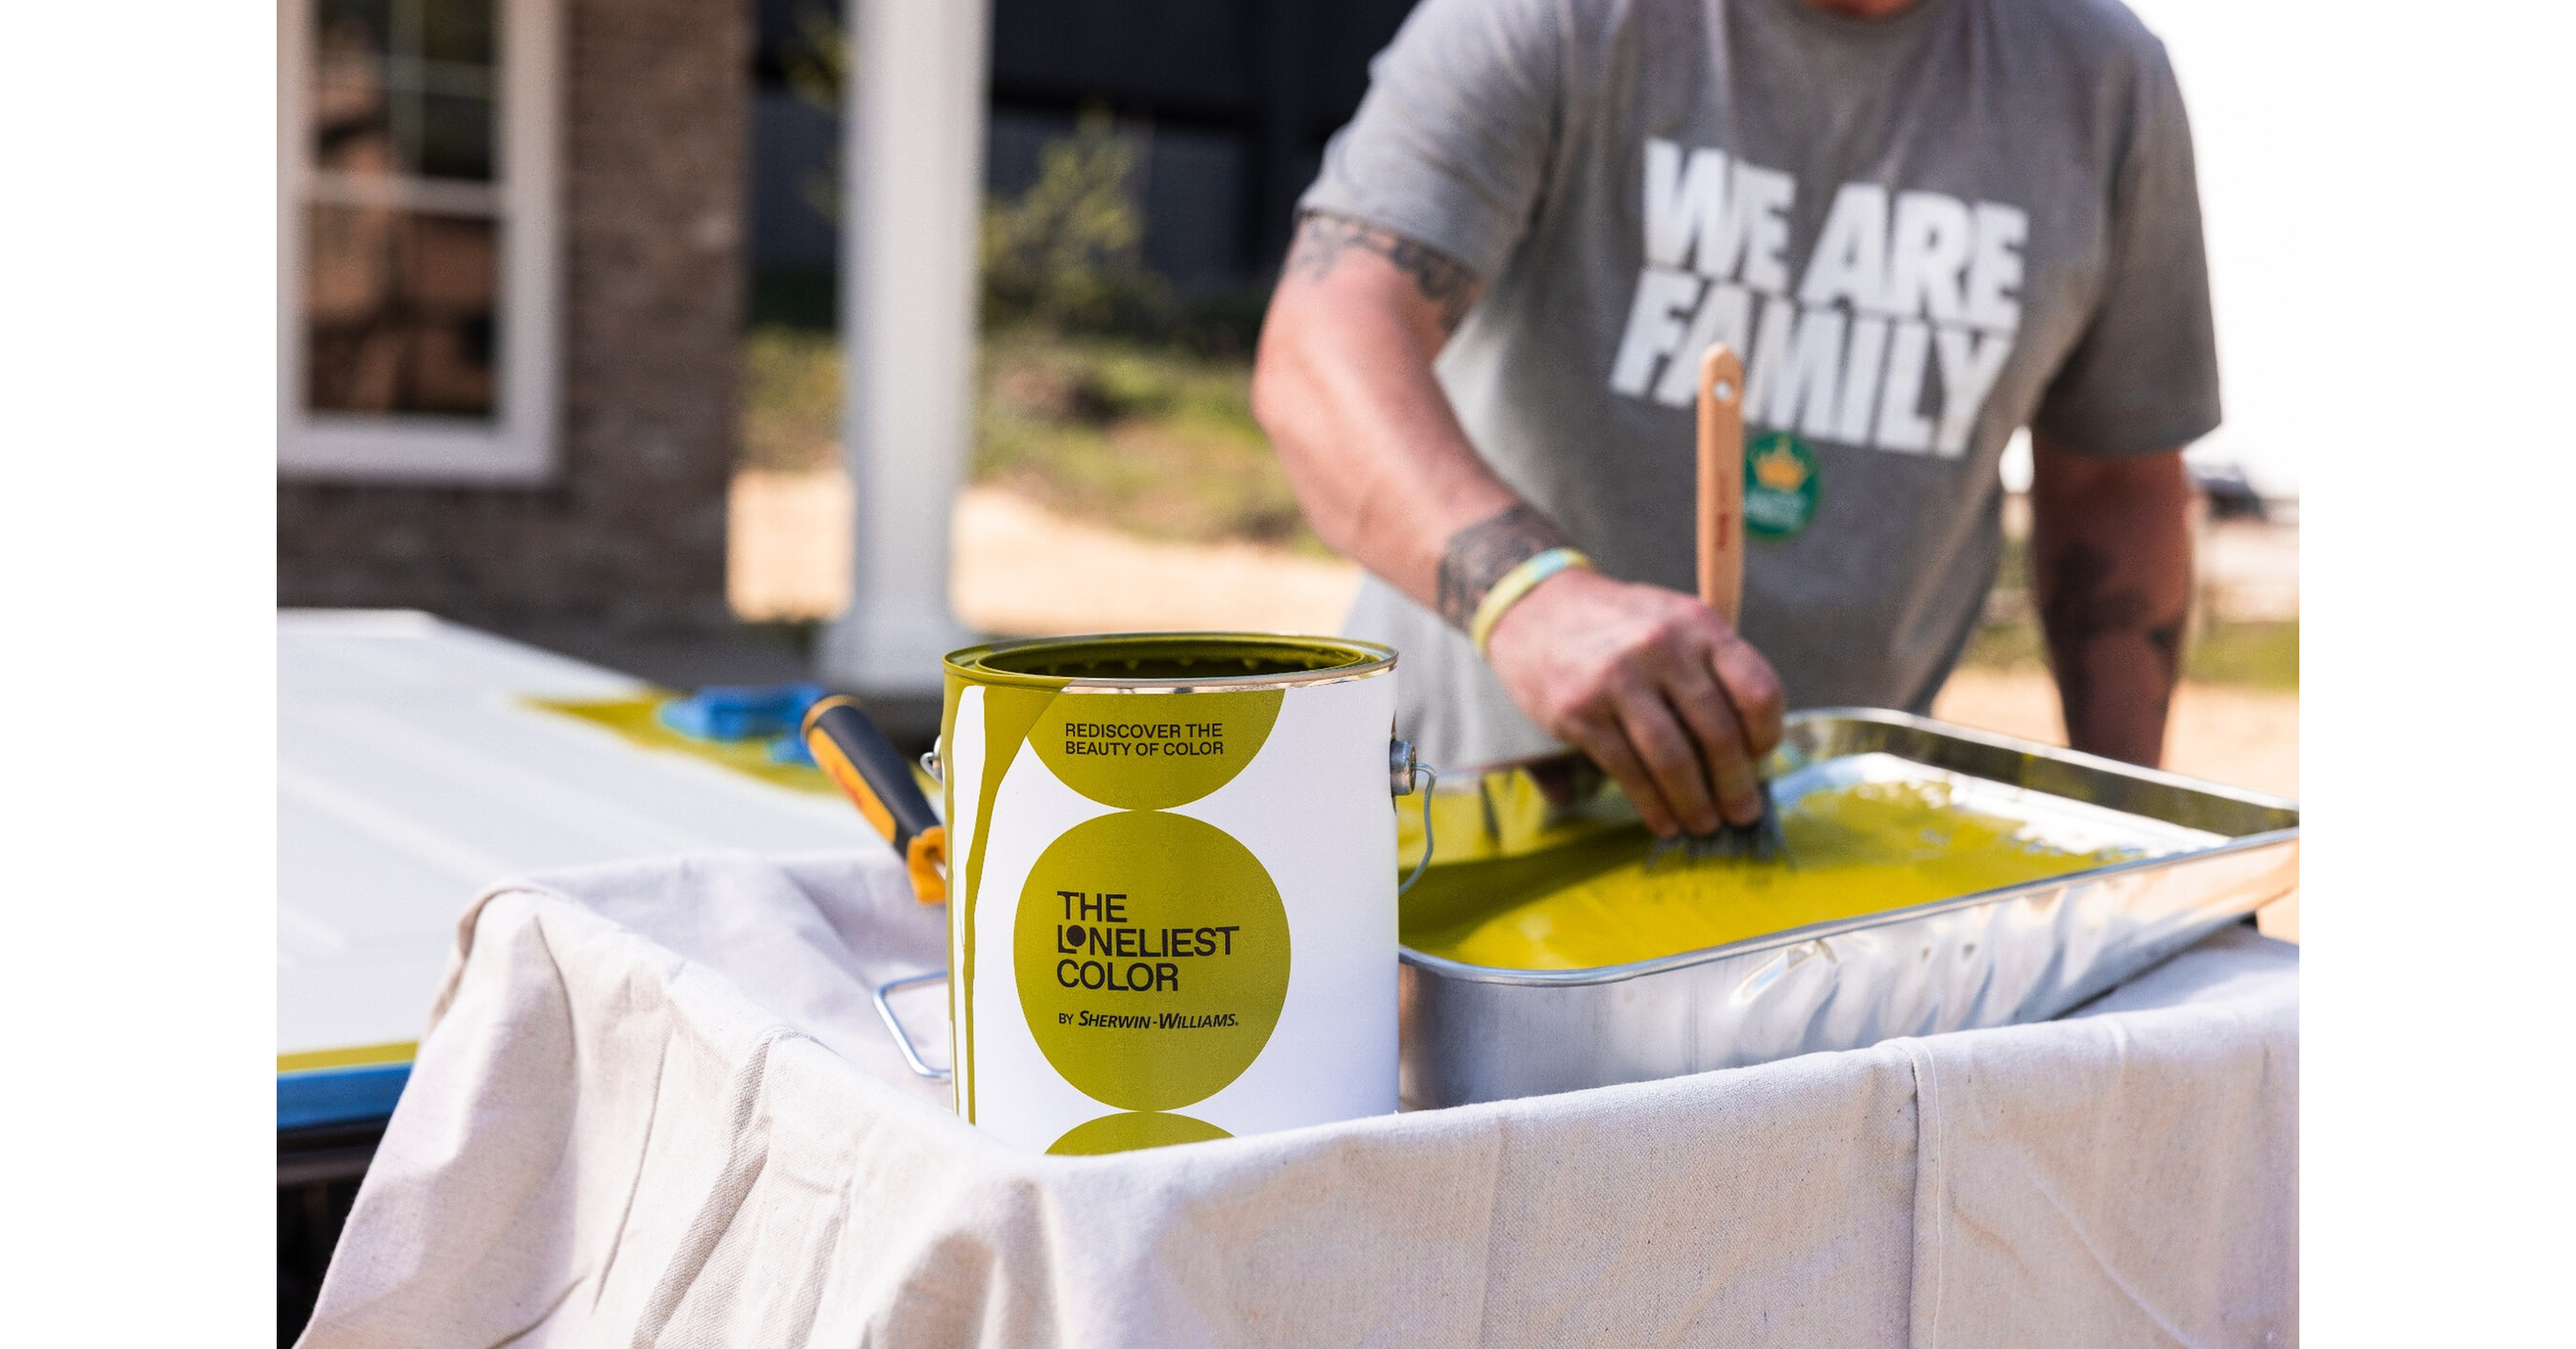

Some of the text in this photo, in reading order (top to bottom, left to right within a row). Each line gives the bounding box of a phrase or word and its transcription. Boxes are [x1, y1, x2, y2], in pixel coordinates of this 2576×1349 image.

[1643, 137, 2029, 330] WE ARE
[1610, 269, 2018, 459] FAMILY
[1066, 722, 1223, 739] REDISCOVER THE
[1066, 740, 1224, 757] BEAUTY OF COLOR
[1056, 890, 1128, 924] THE
[1056, 959, 1179, 992] COLOR
[1058, 1012, 1074, 1026] BY
